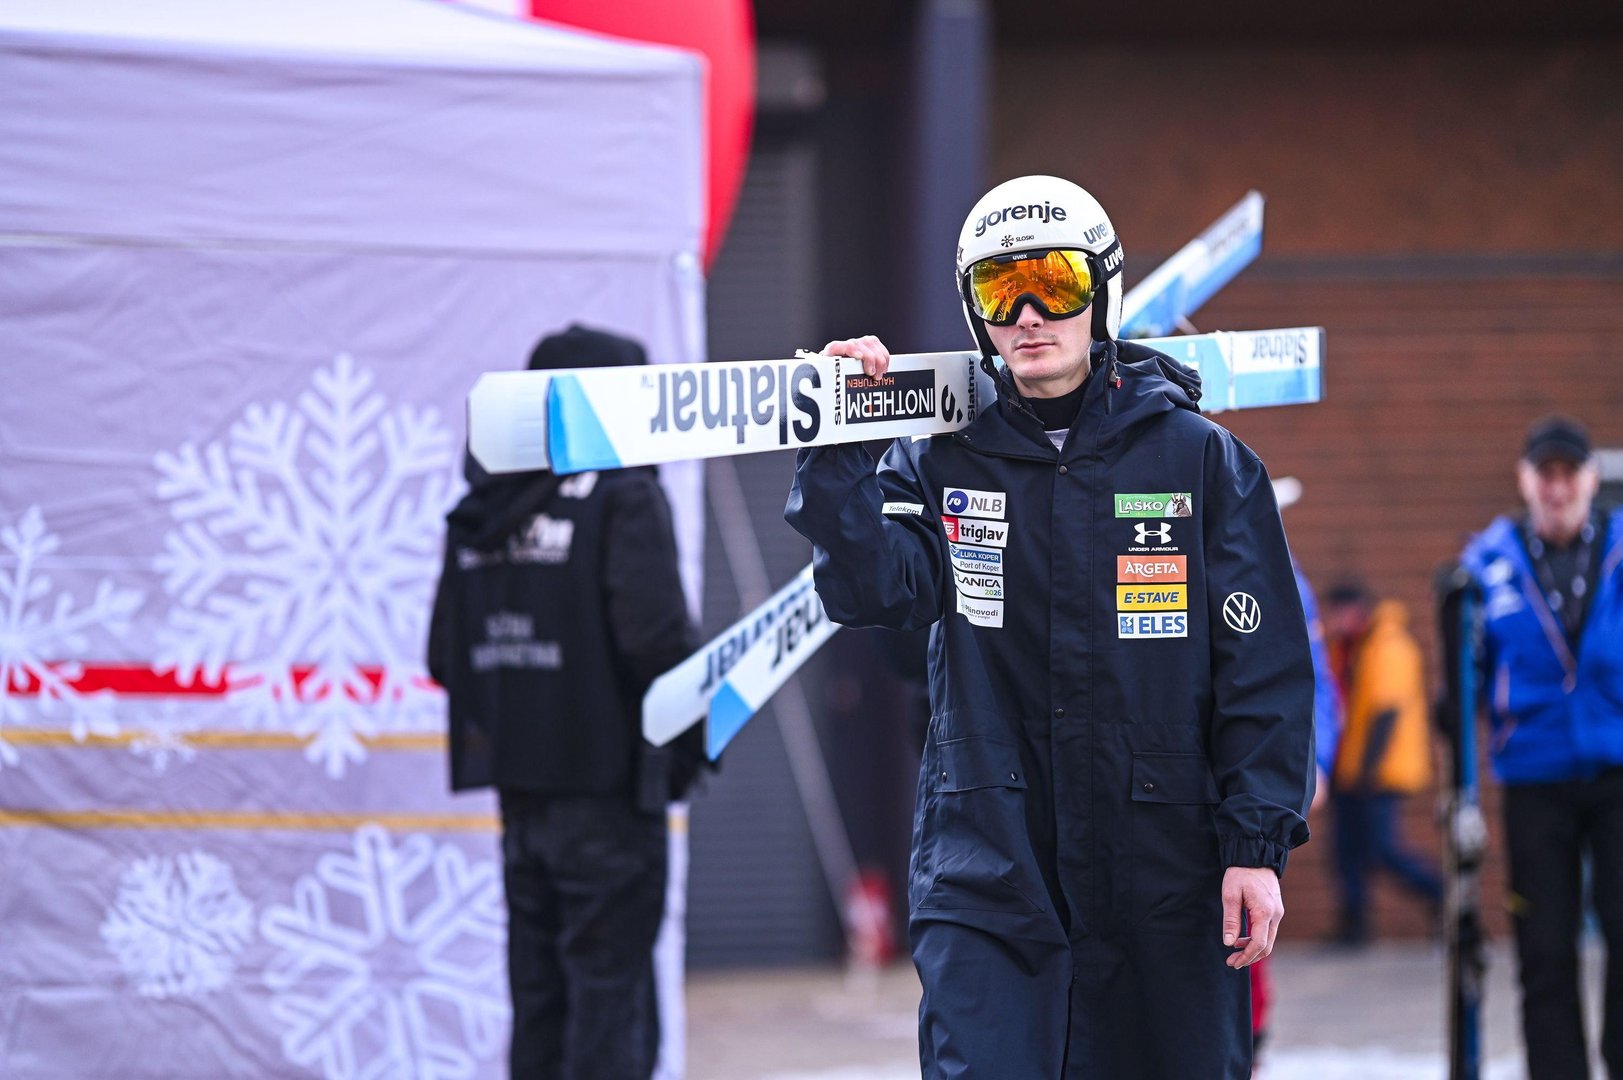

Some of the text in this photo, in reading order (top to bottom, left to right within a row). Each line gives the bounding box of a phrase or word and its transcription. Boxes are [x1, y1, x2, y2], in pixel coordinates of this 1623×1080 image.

[975, 201, 1067, 238] gorenje
[1015, 234, 1035, 243] SLOSKI
[1083, 222, 1109, 245] uve
[1012, 253, 1028, 261] uvex
[1104, 246, 1124, 272] uve
[847, 377, 895, 390] HAUSTÜREN
[967, 358, 975, 422] Slatnar
[650, 363, 822, 445] Slatnar
[847, 388, 934, 419] INOTHERM
[970, 497, 1002, 513] NLB
[1119, 499, 1164, 514] LAŠKO
[960, 524, 1004, 542] triglav
[960, 549, 999, 561] LUKA KOPER
[960, 561, 1000, 573] Port of Koper
[1124, 561, 1179, 578] ARGETA
[984, 589, 1002, 597] 2026
[1139, 615, 1185, 634] ELES
